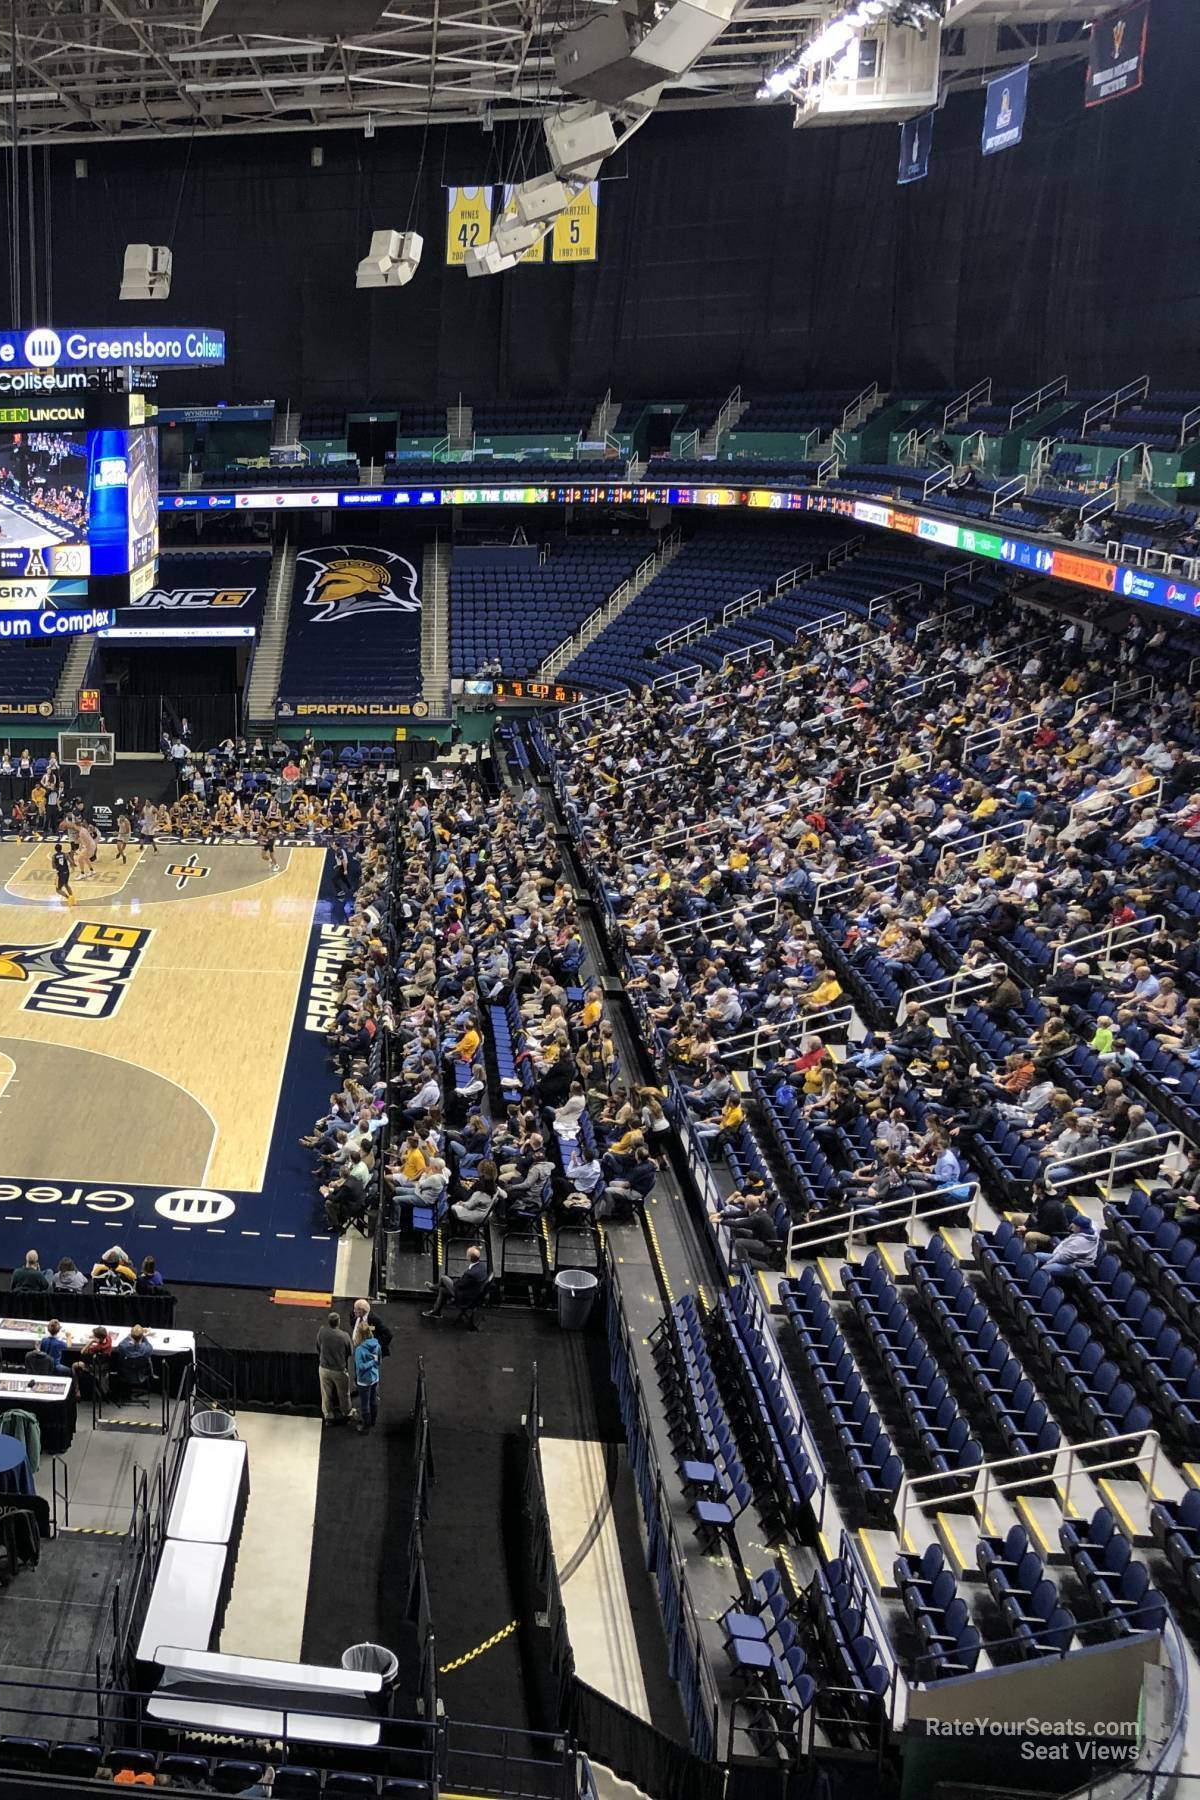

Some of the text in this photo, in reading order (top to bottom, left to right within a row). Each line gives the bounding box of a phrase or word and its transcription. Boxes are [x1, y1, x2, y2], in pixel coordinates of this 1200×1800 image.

[458, 223, 480, 248] 42
[570, 219, 580, 244] 5
[66, 332, 181, 361] Greensboro
[29, 407, 85, 421] LINCOLN
[463, 491, 477, 501] DO
[480, 490, 500, 501] THE
[502, 490, 525, 501] DEW
[705, 492, 719, 505] 18
[770, 495, 782, 508] 20
[55, 551, 82, 573] 20
[39, 609, 109, 634] Complex
[0, 704, 38, 714] CLUB
[81, 699, 96, 711] 24
[296, 704, 411, 715] SPARTAN CLUB
[92, 806, 112, 814] TFA
[24, 922, 145, 1017] UNCG
